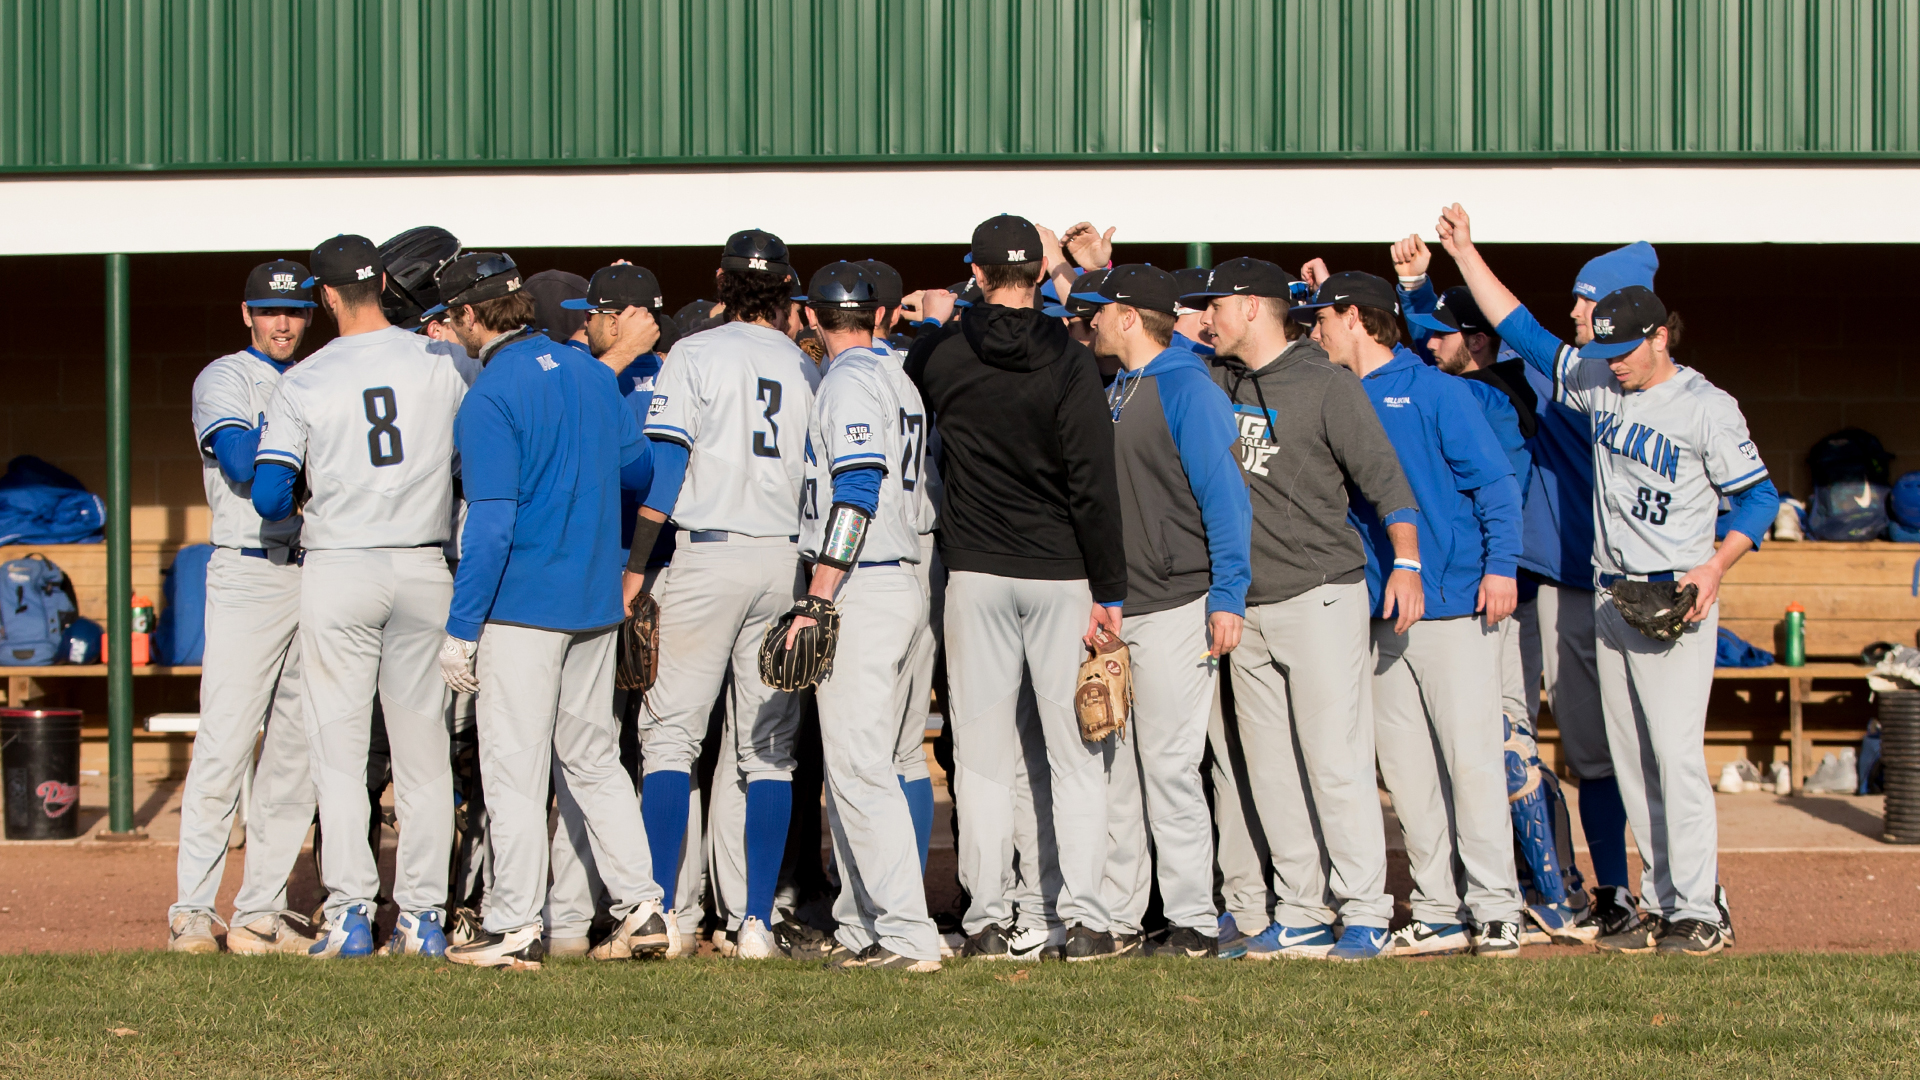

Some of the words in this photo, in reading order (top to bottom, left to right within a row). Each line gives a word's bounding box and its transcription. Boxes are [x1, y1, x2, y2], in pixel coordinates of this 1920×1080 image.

[1007, 249, 1026, 262] M
[748, 258, 768, 271] M
[272, 273, 294, 282] BIG
[356, 265, 375, 281] M
[268, 281, 298, 291] BLUE
[506, 276, 522, 292] M
[535, 353, 560, 372] M
[753, 377, 782, 459] 3
[362, 385, 404, 468] 8
[847, 425, 868, 434] BIG
[843, 432, 874, 444] BLUE
